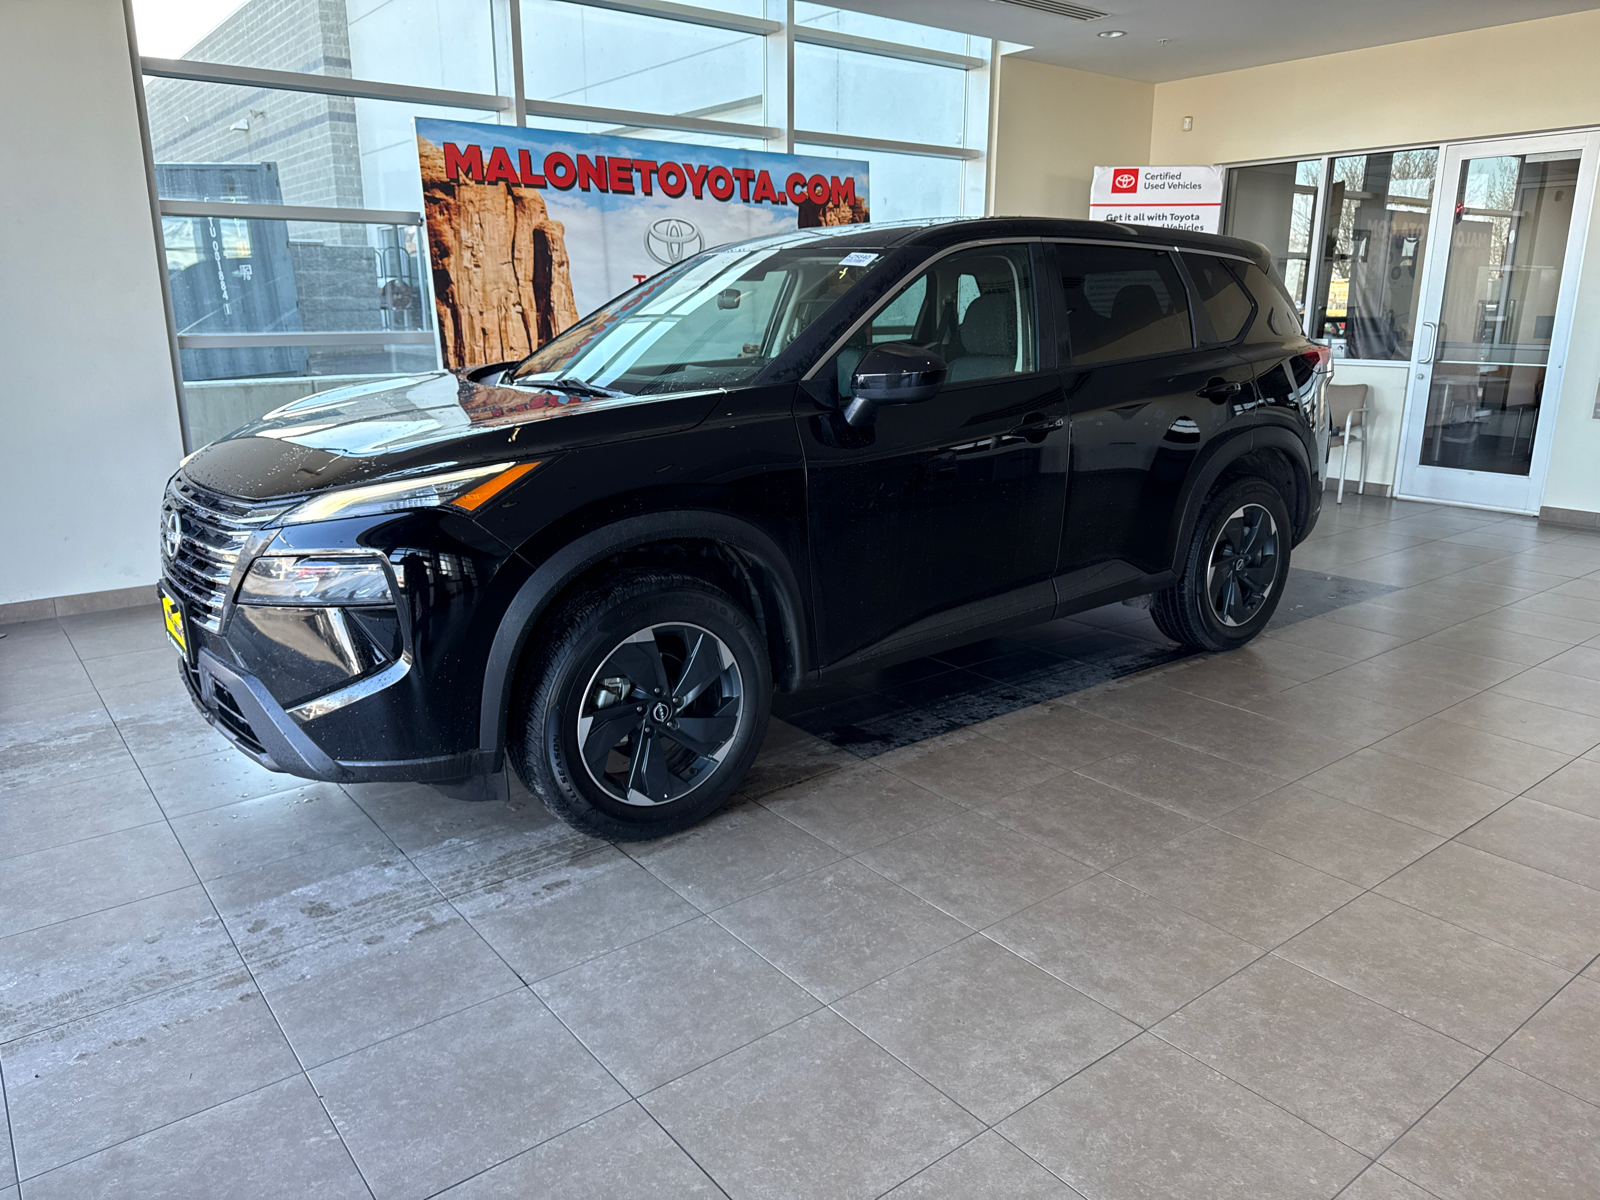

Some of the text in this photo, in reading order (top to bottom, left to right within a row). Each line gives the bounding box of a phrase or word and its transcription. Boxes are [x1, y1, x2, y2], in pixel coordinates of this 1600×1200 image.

[442, 142, 856, 207] MALONETOYOTA.COM
[1144, 172, 1182, 180] Certified
[1144, 182, 1202, 190] Used Vehicles
[1106, 213, 1200, 222] Get it all with Toyota
[552, 734, 583, 805] ALL SEASON
